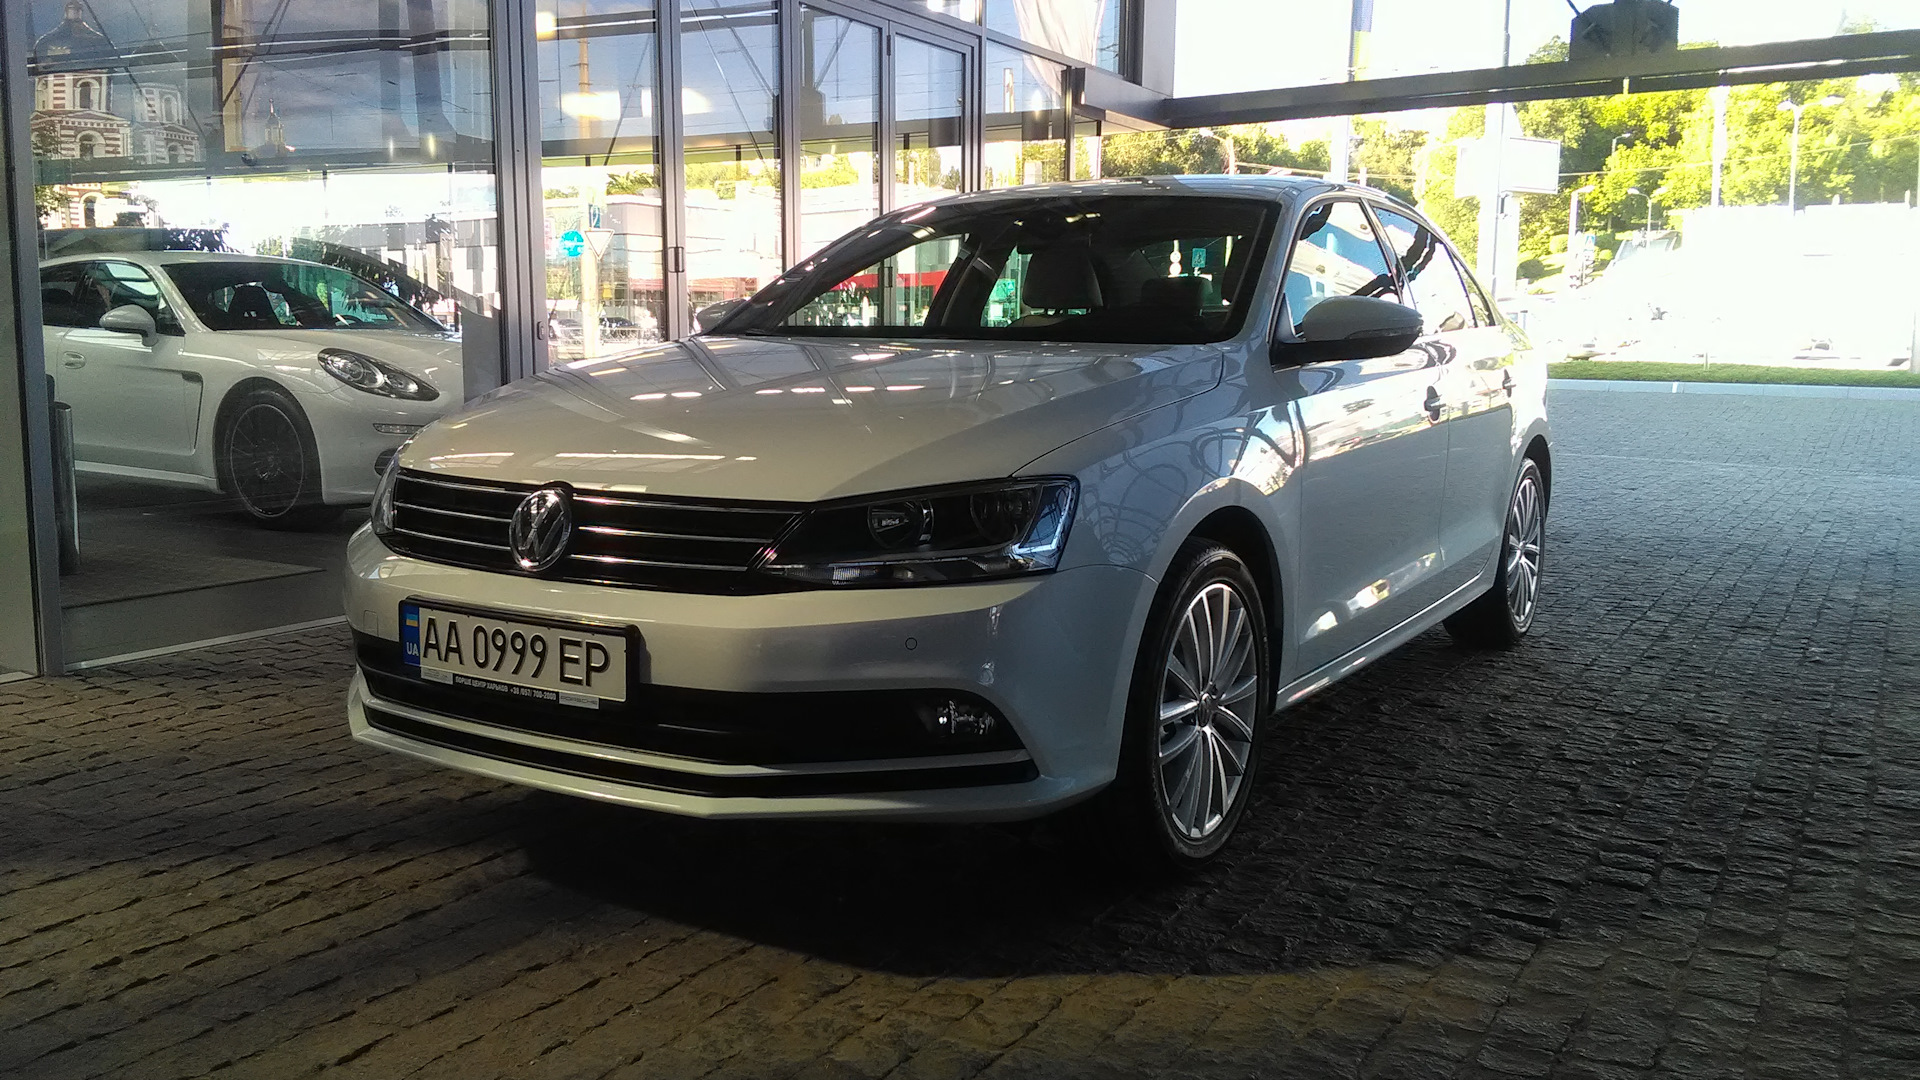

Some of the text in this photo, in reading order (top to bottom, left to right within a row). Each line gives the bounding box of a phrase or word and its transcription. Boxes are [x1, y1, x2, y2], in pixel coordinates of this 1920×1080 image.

[406, 642, 419, 657] UA
[423, 617, 610, 687] AA 0999 EP
